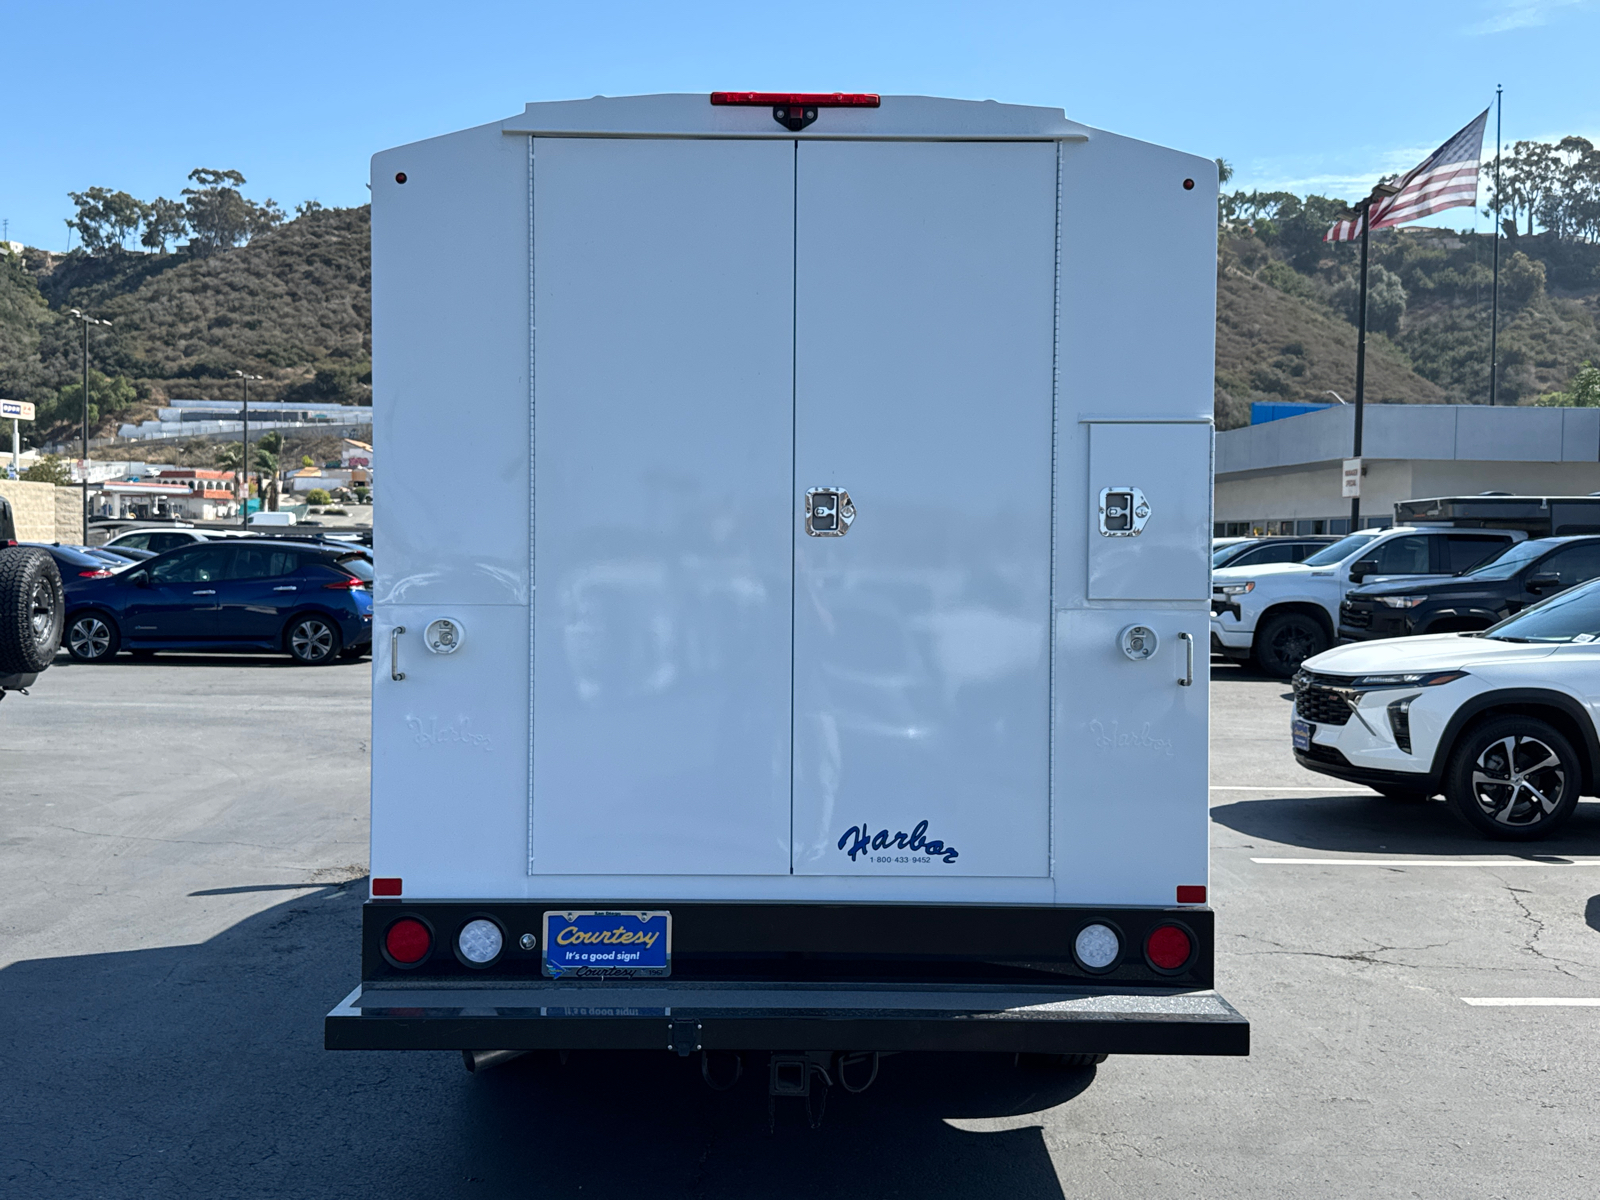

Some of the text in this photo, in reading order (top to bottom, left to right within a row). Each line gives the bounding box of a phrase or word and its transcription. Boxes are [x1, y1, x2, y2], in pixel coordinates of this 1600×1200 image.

[837, 819, 959, 864] Harbor
[556, 925, 660, 949] Courtesy
[565, 951, 580, 960] It's
[589, 951, 616, 962] good
[616, 951, 640, 962] sign!
[575, 966, 637, 979] Courtesy
